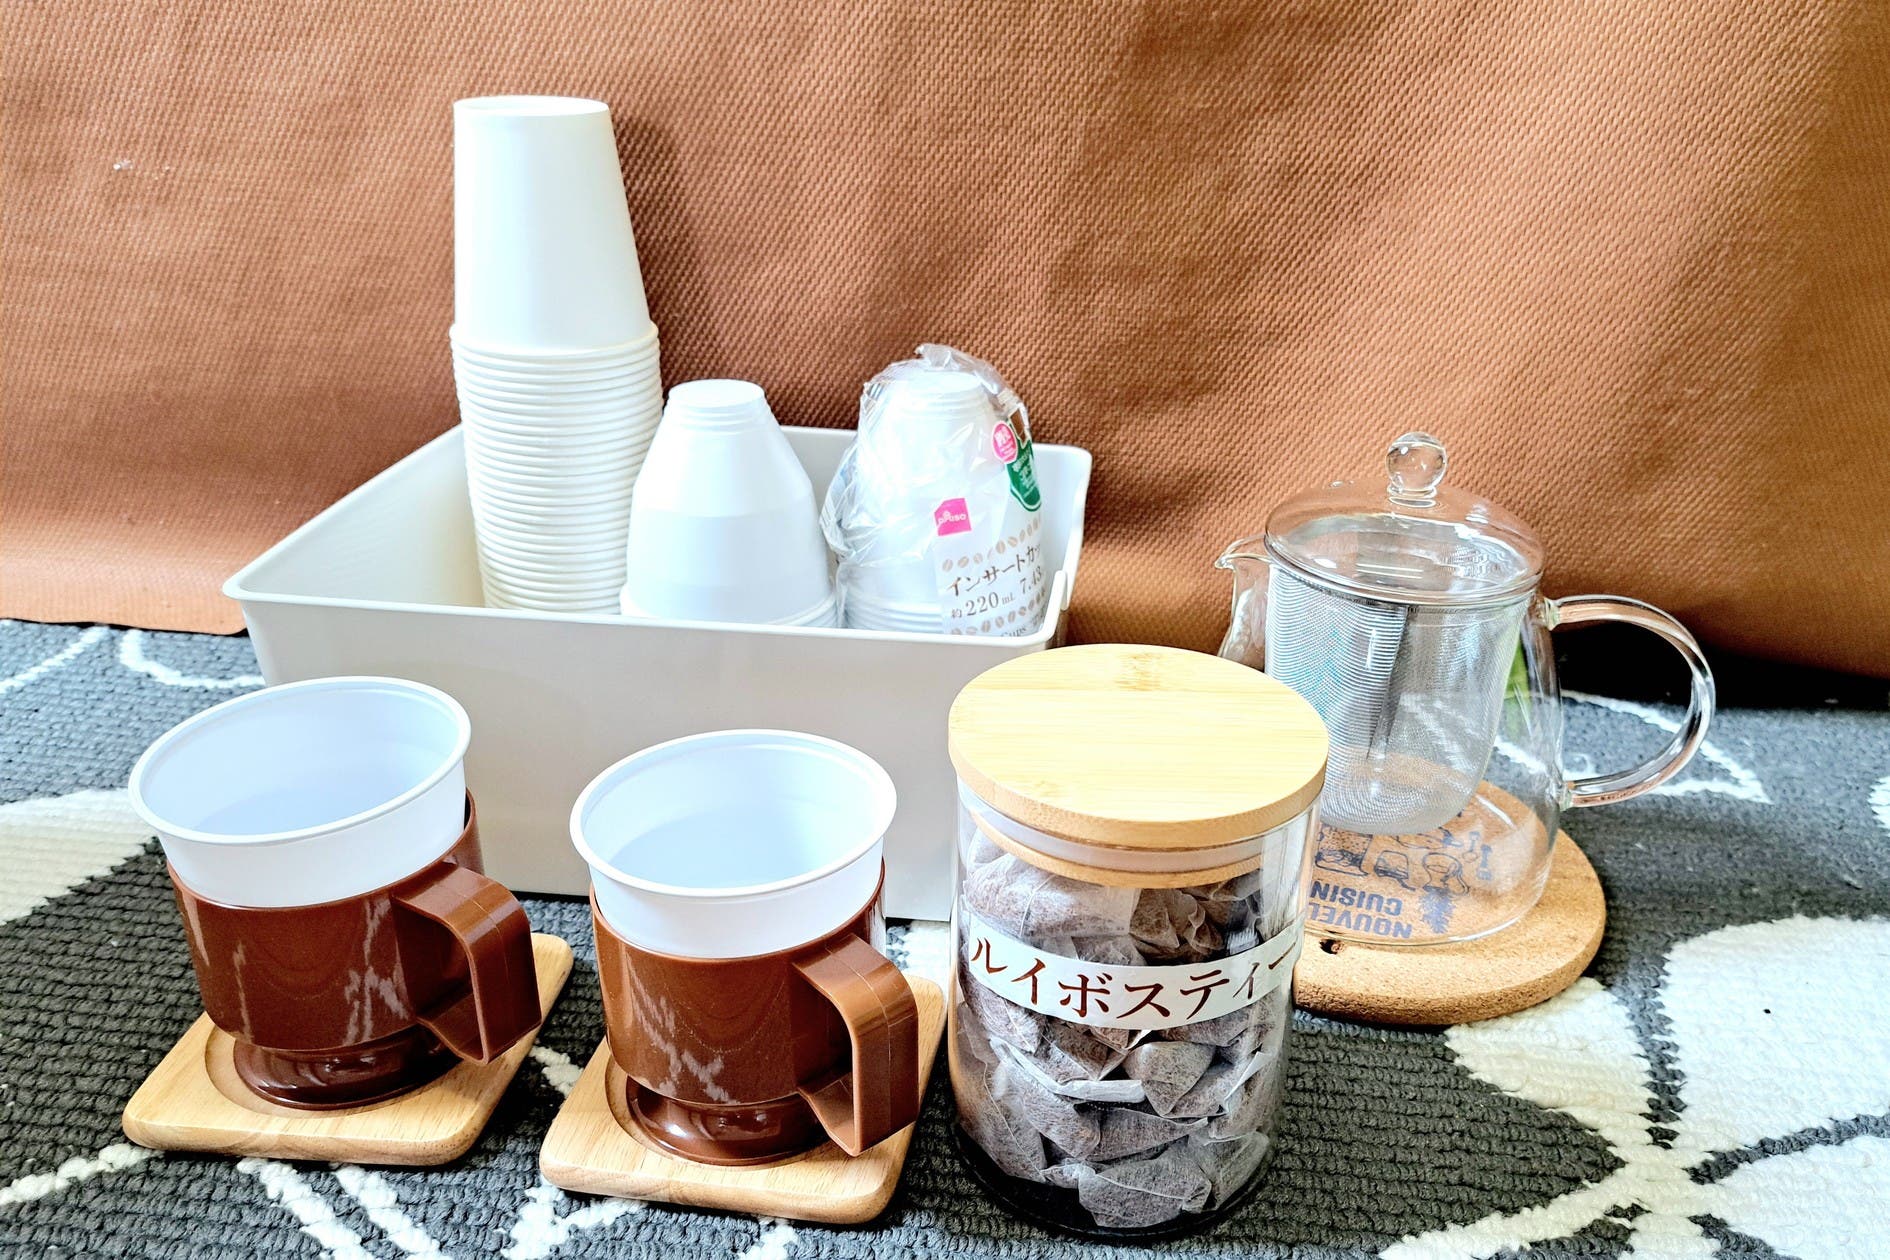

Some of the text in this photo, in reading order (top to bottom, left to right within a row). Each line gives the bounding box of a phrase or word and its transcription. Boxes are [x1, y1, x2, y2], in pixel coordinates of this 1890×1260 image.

[971, 937, 1295, 1019] ルイボスティー
